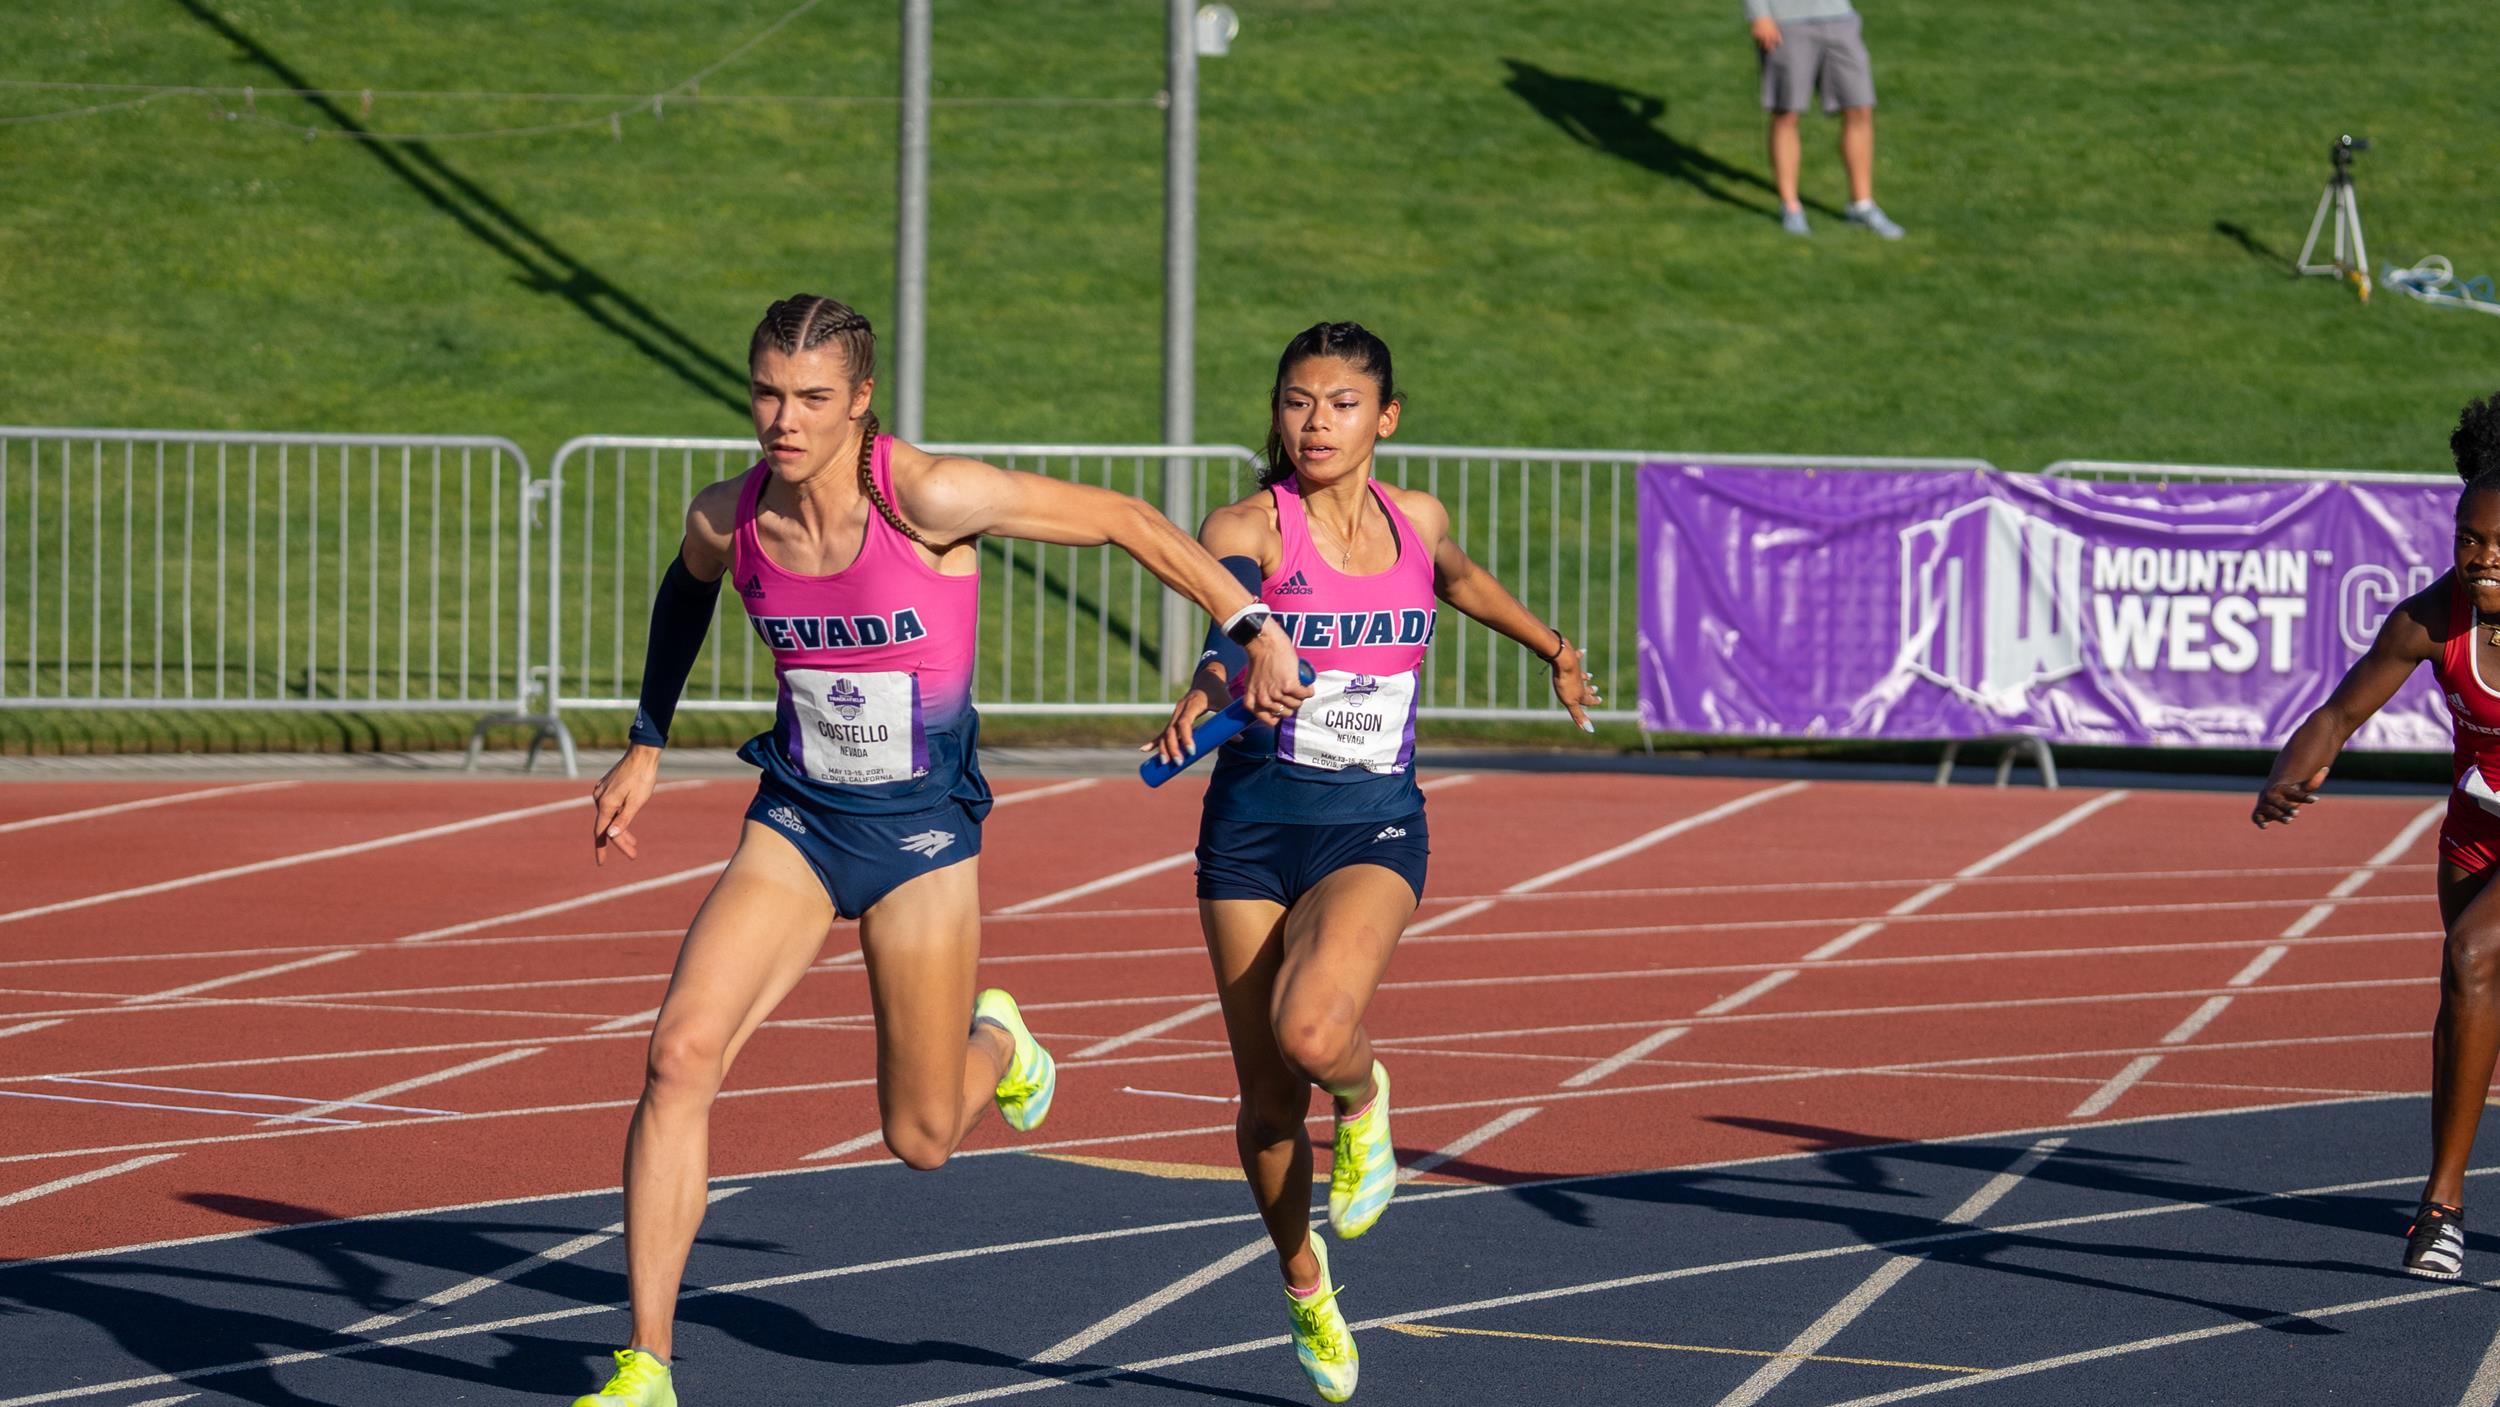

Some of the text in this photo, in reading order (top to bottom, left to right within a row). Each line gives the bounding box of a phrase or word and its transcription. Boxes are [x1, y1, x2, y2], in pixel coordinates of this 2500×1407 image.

[2093, 546, 2308, 593] MOUNTAIN
[1275, 586, 1313, 595] adidas
[2093, 594, 2307, 673] WEST
[1325, 709, 1383, 732] CARSON
[818, 720, 888, 743] COSTELLO
[1336, 734, 1365, 745] NEVADA
[840, 745, 868, 758] NEVADA
[829, 767, 842, 775] MAY
[850, 774, 894, 783] CALIFORNIA
[768, 808, 806, 835] adidas
